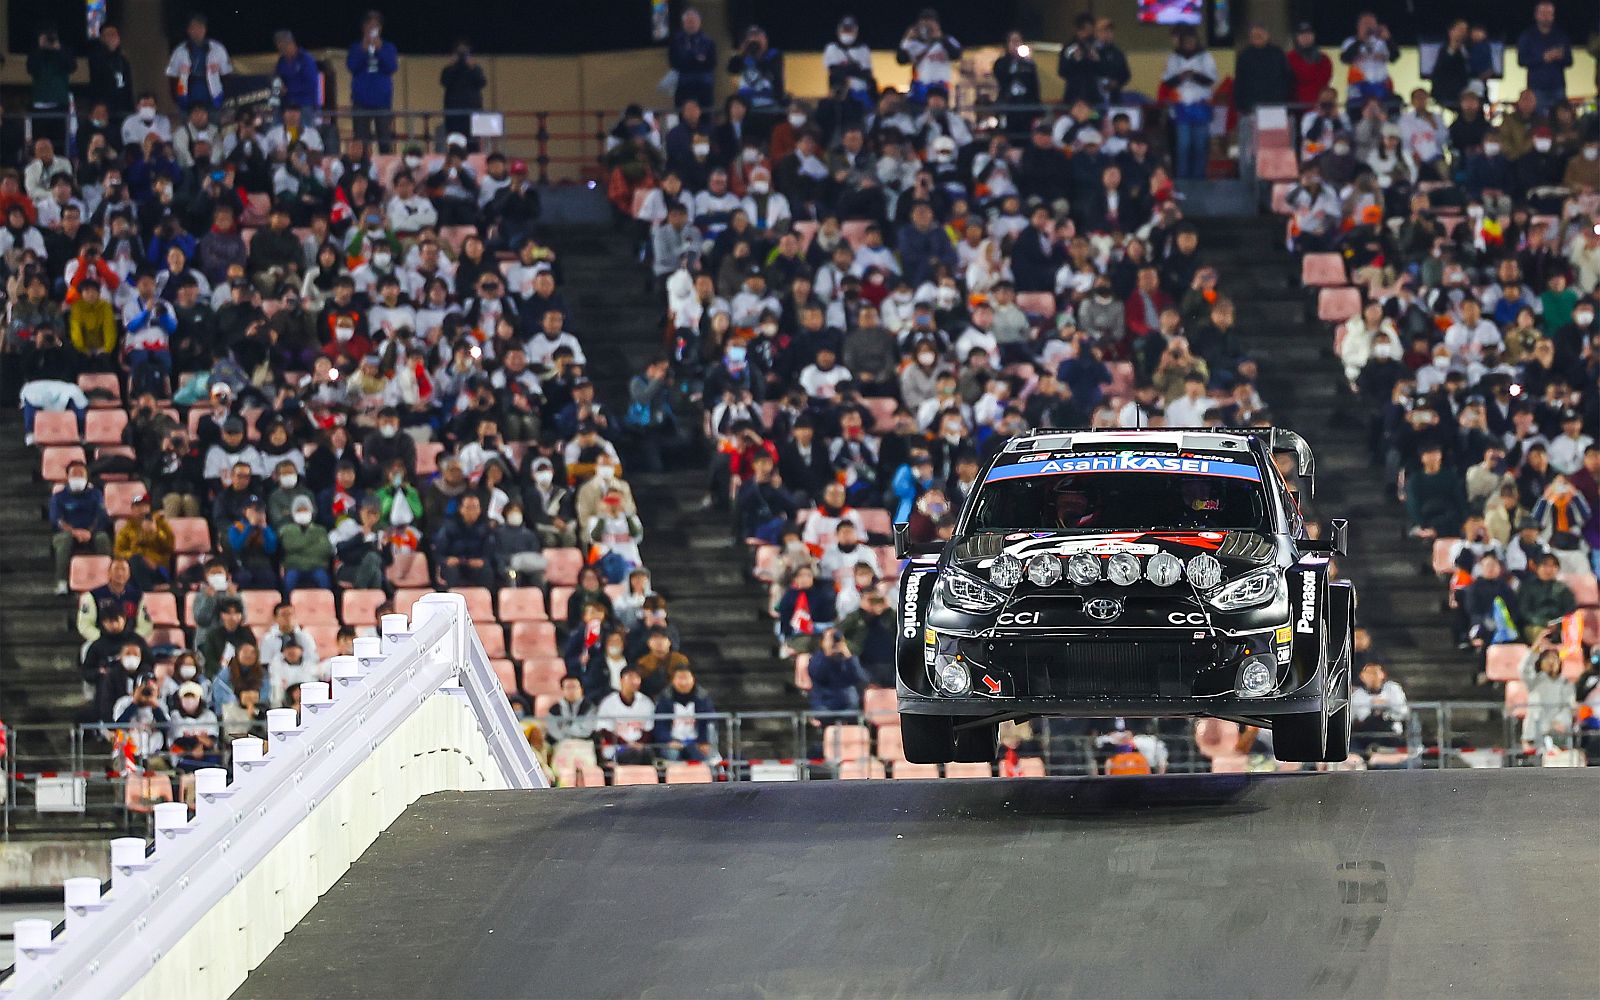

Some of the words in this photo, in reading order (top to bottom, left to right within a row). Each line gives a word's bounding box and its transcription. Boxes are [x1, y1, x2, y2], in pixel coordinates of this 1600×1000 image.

[1053, 450, 1116, 459] TOYOTA
[1180, 452, 1234, 463] Racing
[997, 611, 1040, 625] CCI
[1167, 612, 1211, 625] CCI
